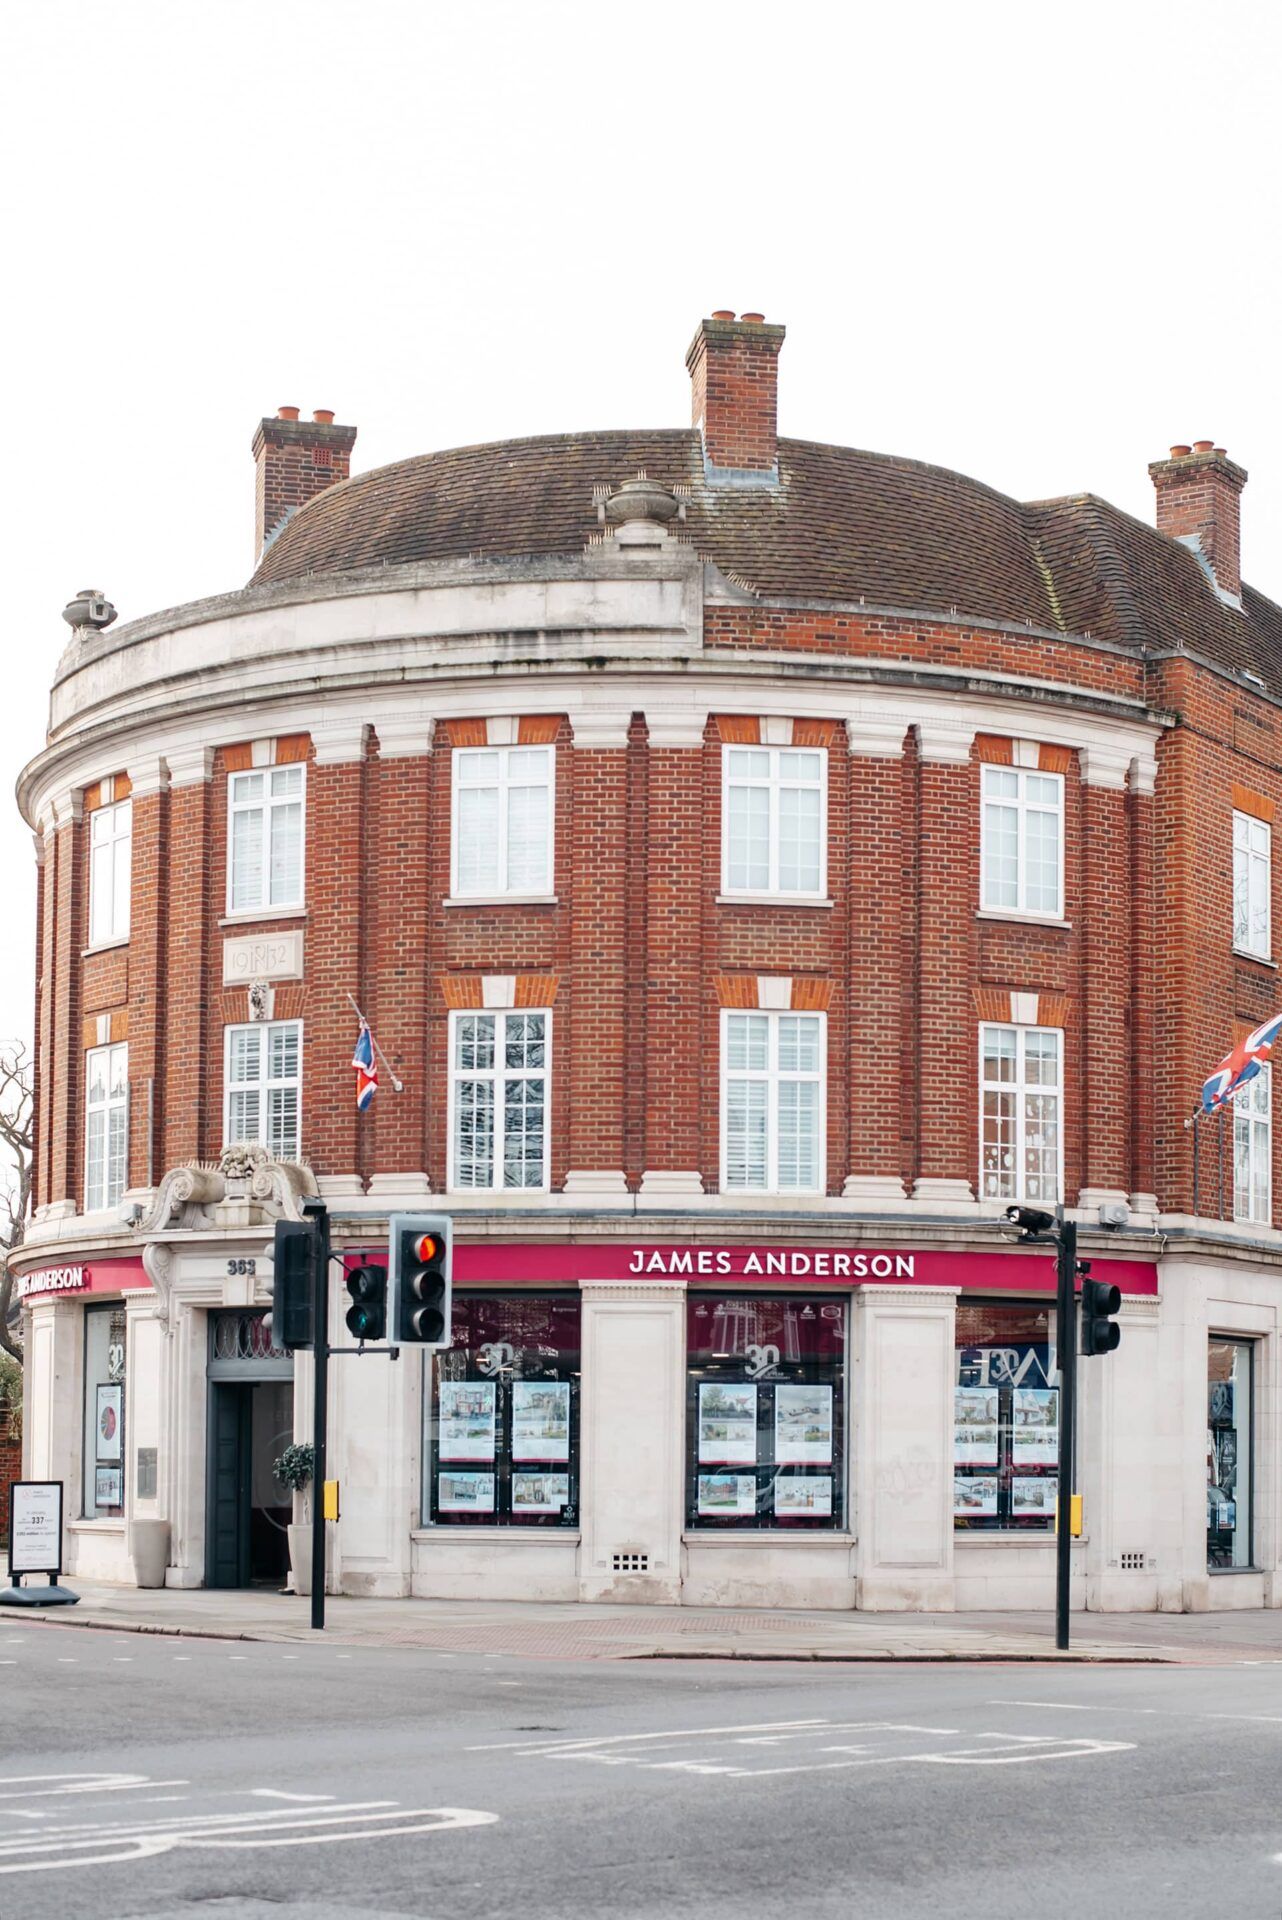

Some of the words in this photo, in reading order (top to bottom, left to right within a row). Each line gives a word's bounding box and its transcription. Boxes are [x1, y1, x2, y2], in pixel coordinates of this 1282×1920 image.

[629, 1250, 732, 1274] JAMES
[743, 1252, 915, 1278] ANDERSON
[30, 1266, 83, 1293] ANDERSON
[31, 1516, 44, 1525] 337
